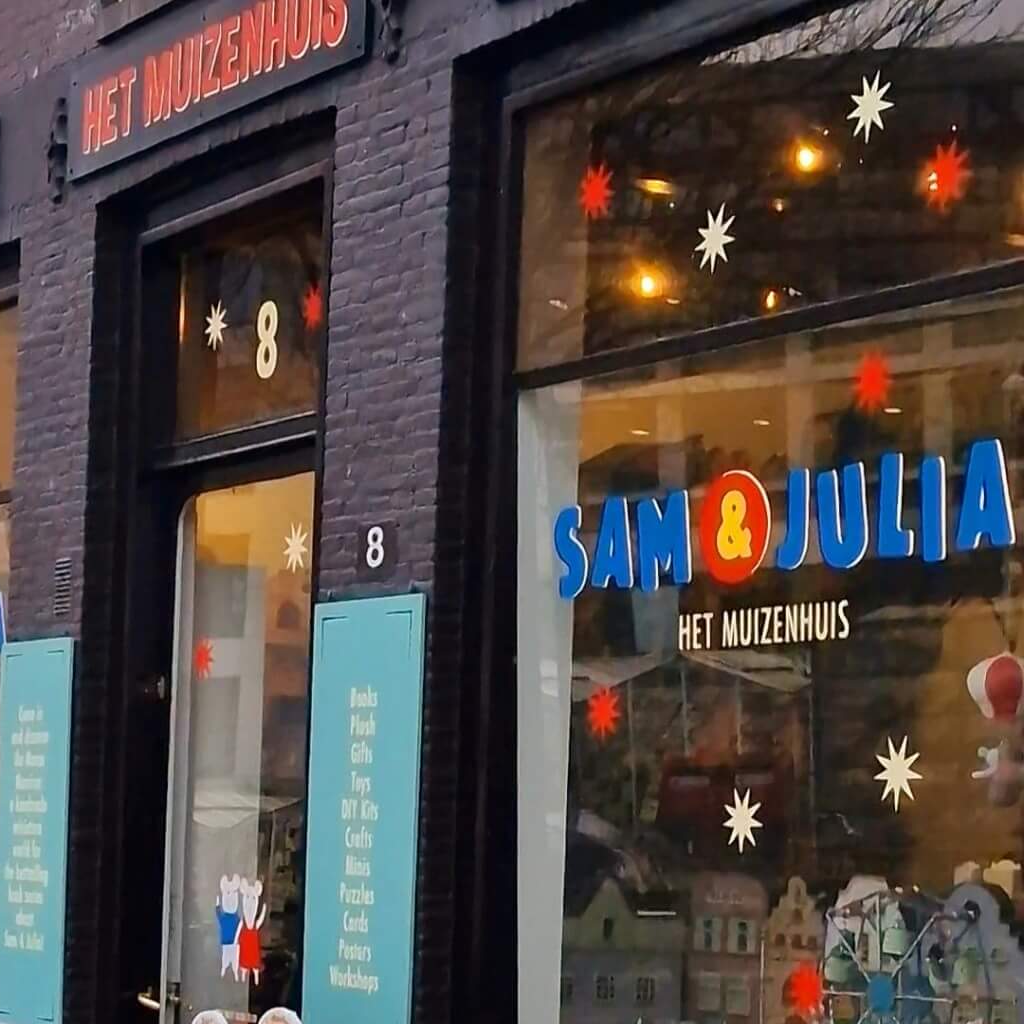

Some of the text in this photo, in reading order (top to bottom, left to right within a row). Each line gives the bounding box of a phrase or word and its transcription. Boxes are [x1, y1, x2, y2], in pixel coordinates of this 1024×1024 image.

[83, 0, 348, 154] HET MUIZENHUIS
[255, 300, 278, 378] 8
[553, 438, 1016, 600] SAM & JULIA
[366, 526, 384, 567] 8
[679, 599, 850, 650] HET MUIZENHUIS
[350, 685, 378, 708] Books
[351, 741, 373, 764] Gifts
[351, 771, 371, 797] Toys
[345, 826, 373, 848] Crafts
[340, 882, 375, 905] Puzzles
[343, 909, 369, 933] Cards
[339, 938, 372, 963] Posters
[329, 965, 379, 995] Workshops
